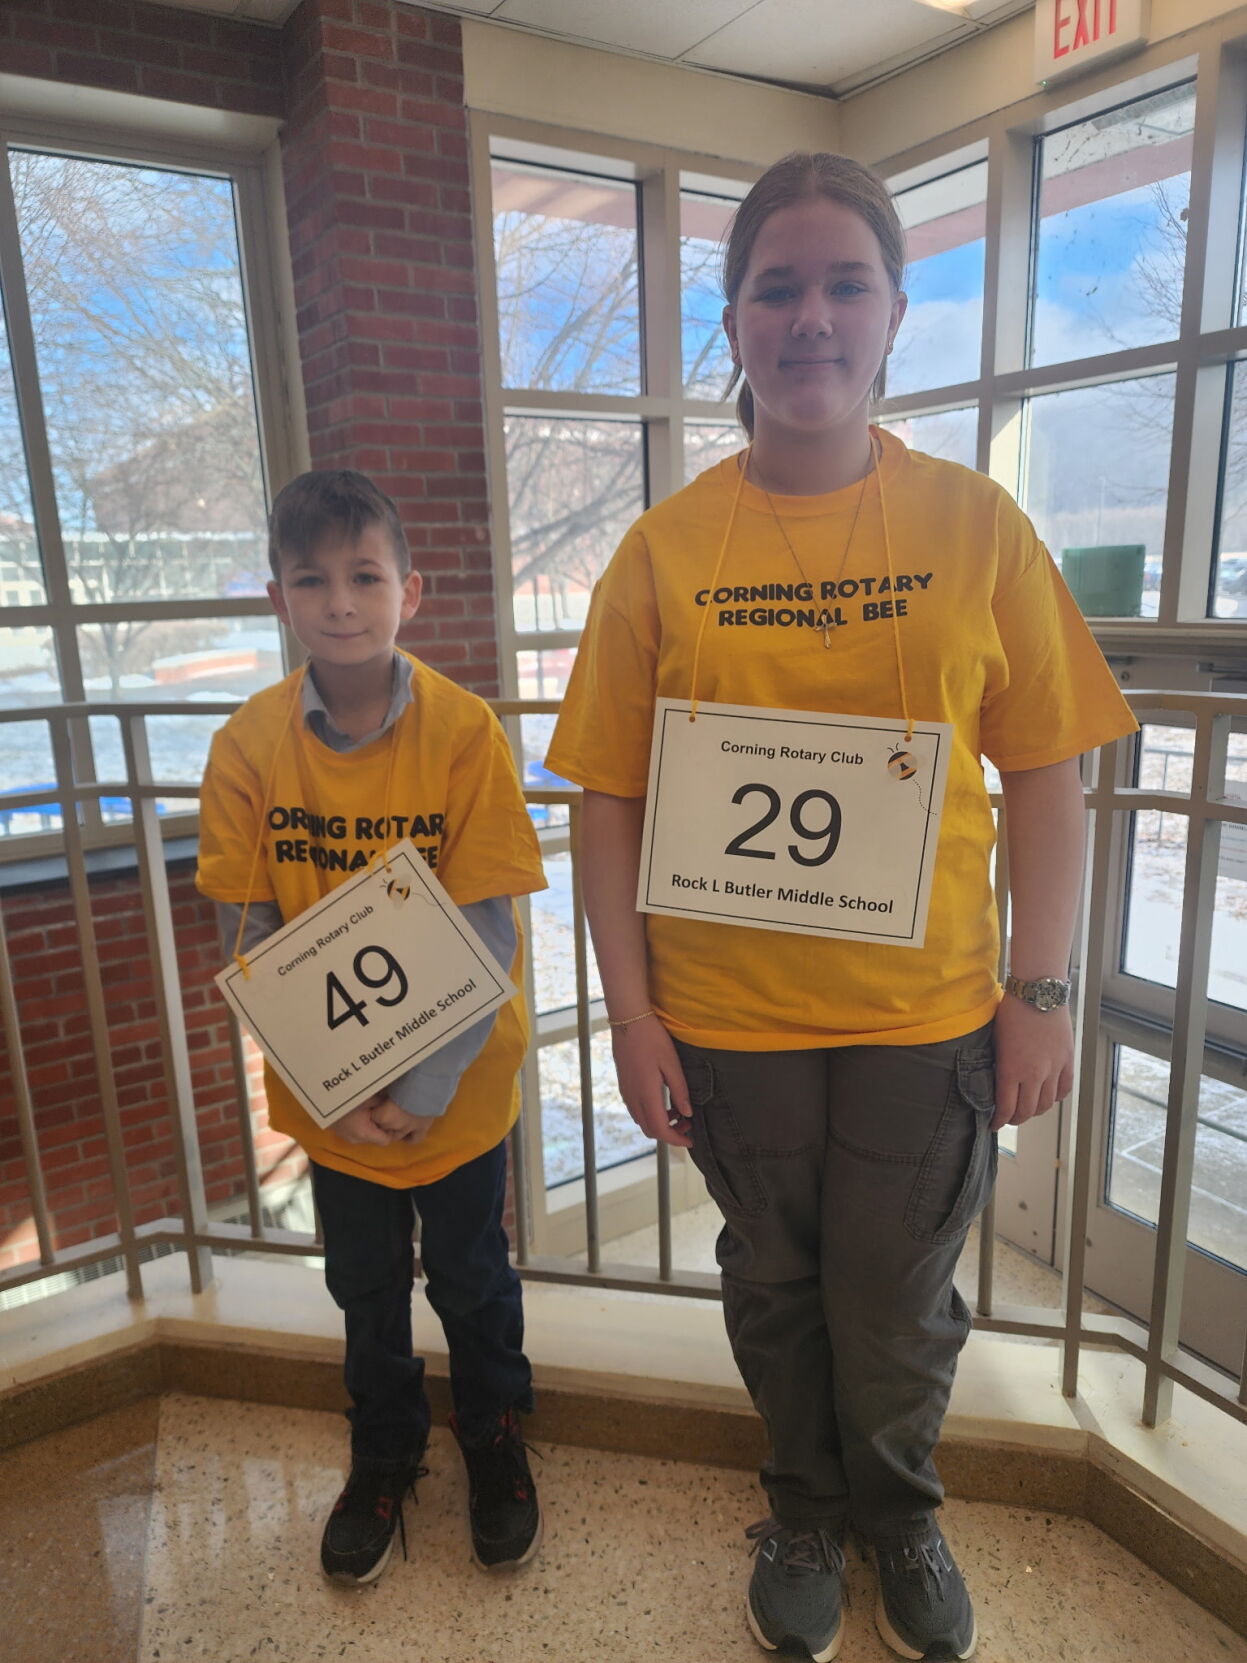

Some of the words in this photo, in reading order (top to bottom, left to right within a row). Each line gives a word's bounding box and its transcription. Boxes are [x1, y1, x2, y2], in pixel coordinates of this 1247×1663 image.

[695, 583, 813, 606] CORNING
[821, 573, 933, 600] ROTARY
[719, 608, 848, 627] REGIONAL
[863, 599, 908, 621] BEE
[721, 740, 776, 759] Corning
[780, 746, 826, 764] Rotary
[830, 750, 864, 765] Club
[724, 783, 842, 867] 29
[672, 874, 708, 891] Rock
[712, 879, 720, 893] L
[725, 880, 773, 900] Butler
[777, 887, 834, 907] Middle
[838, 894, 894, 914] School
[277, 946, 318, 976] Corning
[316, 923, 349, 949] Rotary
[349, 905, 374, 925] Club
[326, 945, 409, 1031] 49
[322, 1068, 352, 1092] Rock
[351, 1062, 361, 1072] L
[359, 1037, 396, 1066] Butler
[395, 1010, 438, 1040] Middle
[437, 978, 477, 1011] School
